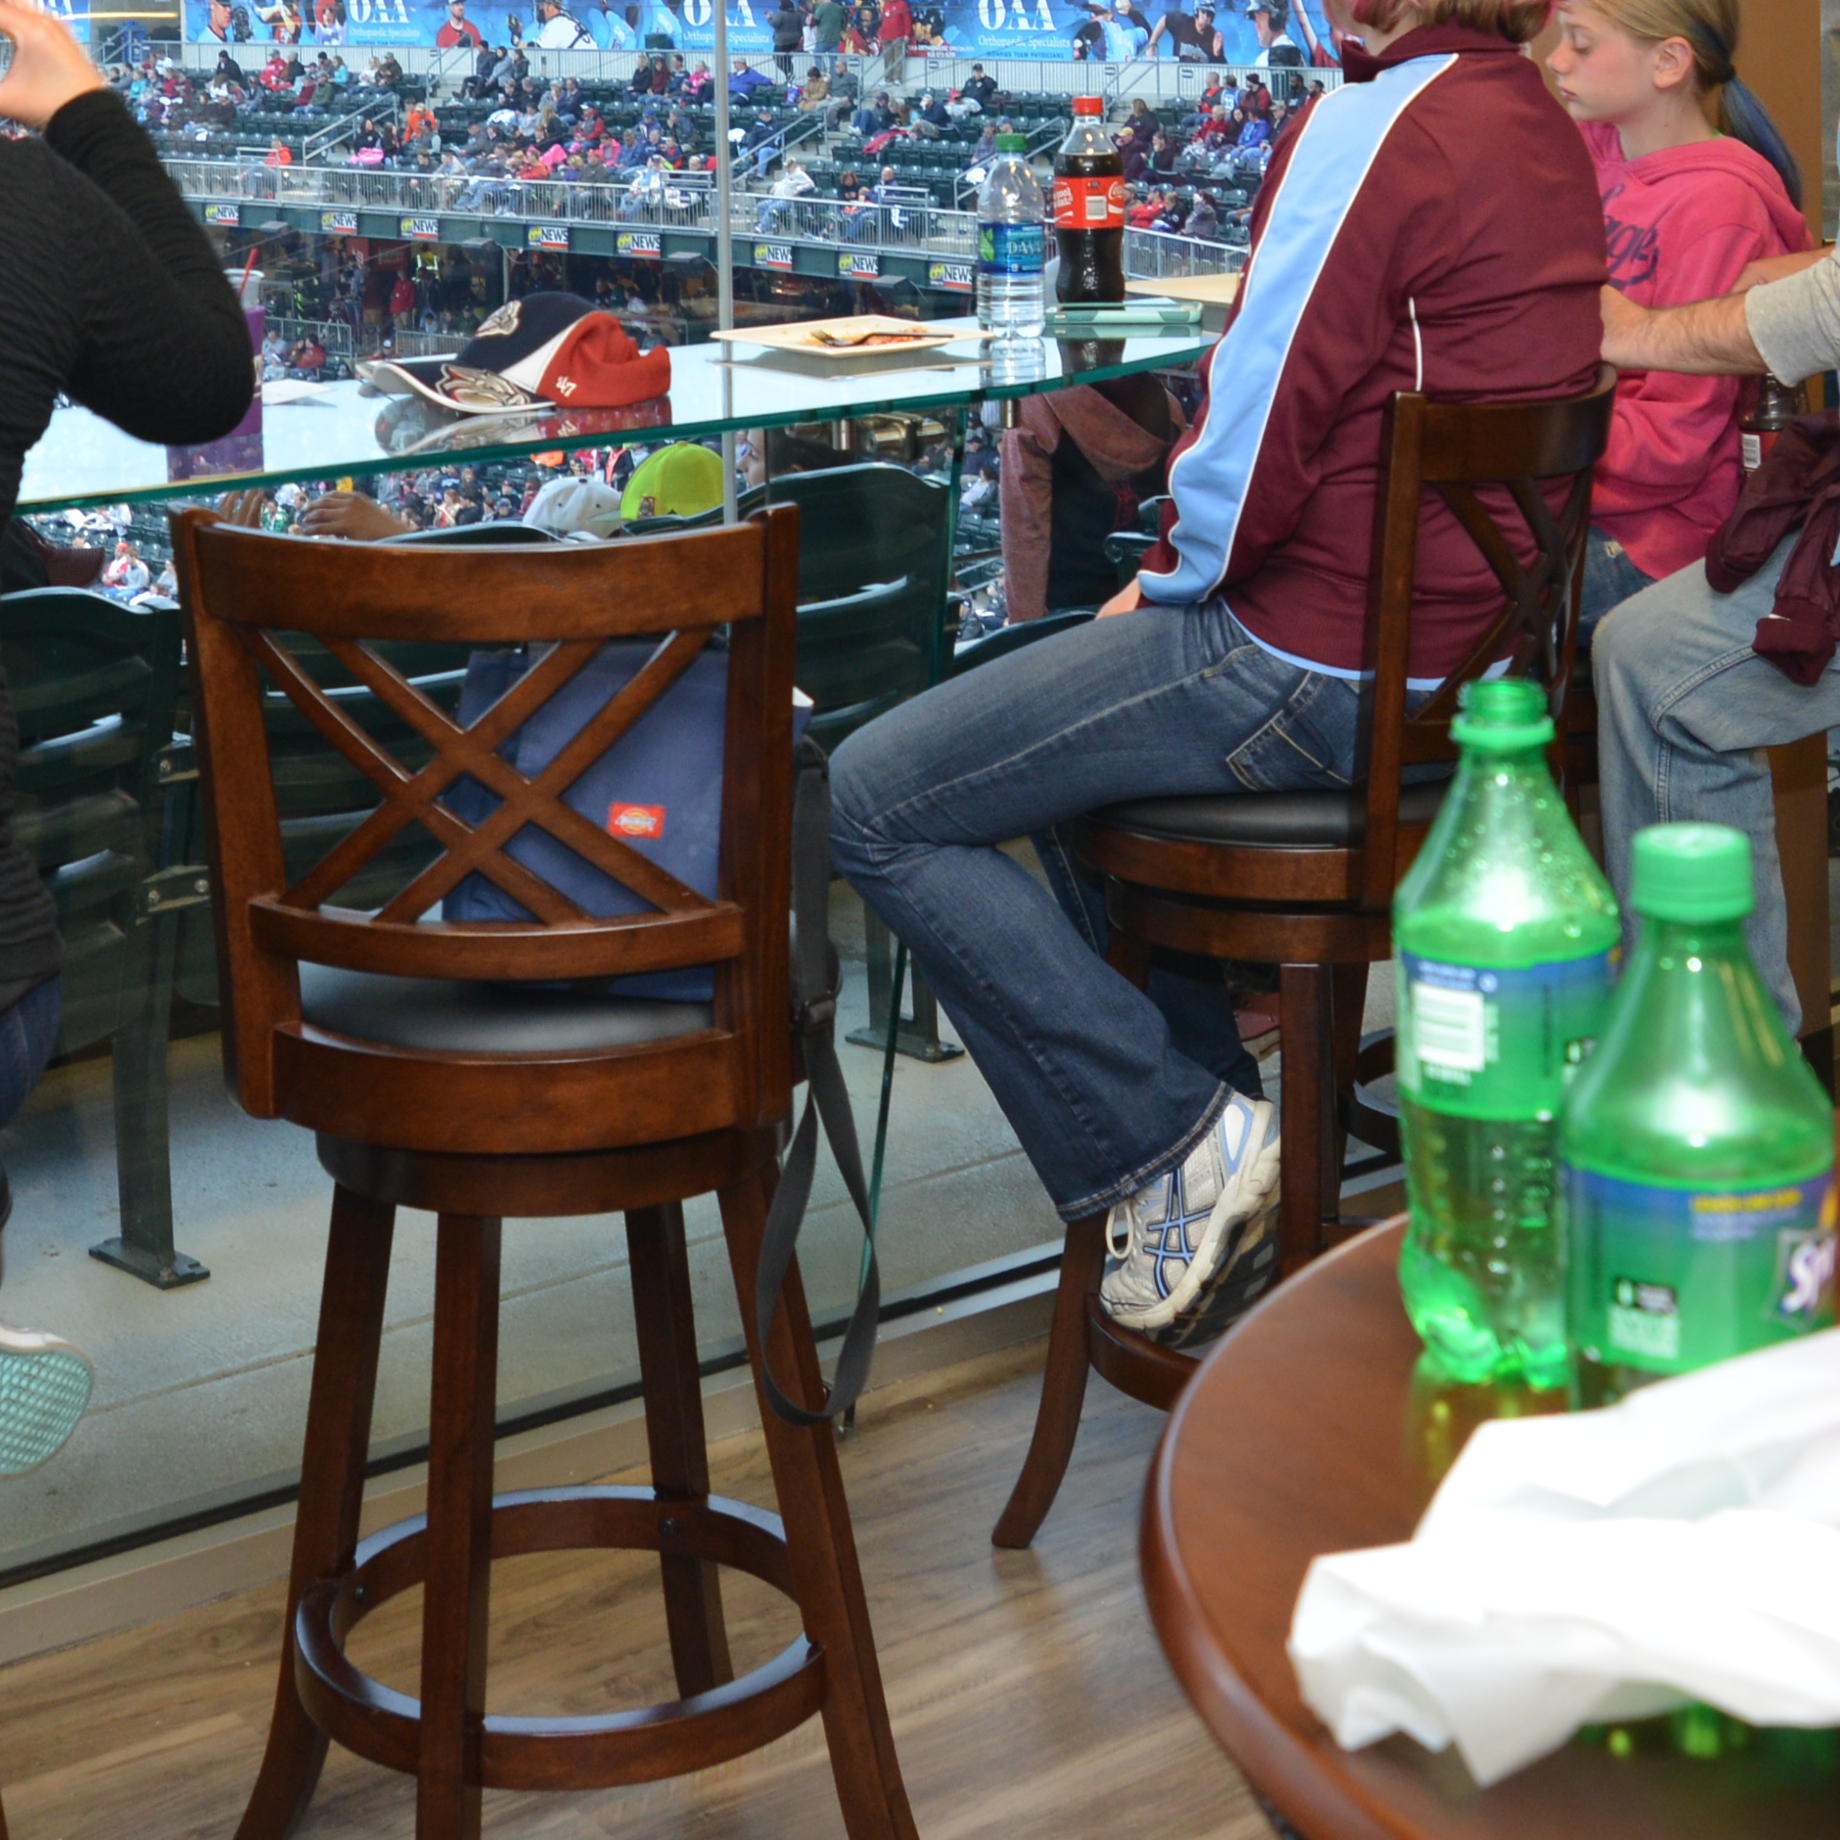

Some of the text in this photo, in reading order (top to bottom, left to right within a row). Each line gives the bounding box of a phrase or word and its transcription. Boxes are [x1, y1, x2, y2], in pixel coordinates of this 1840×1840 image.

[729, 31, 770, 45] Specialists
[1027, 36, 1071, 50] Specialists
[217, 205, 239, 219] NEWS
[333, 213, 358, 229] NEWS
[413, 219, 439, 234] NEWS
[541, 228, 569, 243] NEWS
[631, 234, 661, 250] NEWS
[767, 246, 793, 261] NEWS
[852, 255, 879, 272] NEWS
[943, 265, 973, 283] NEWS
